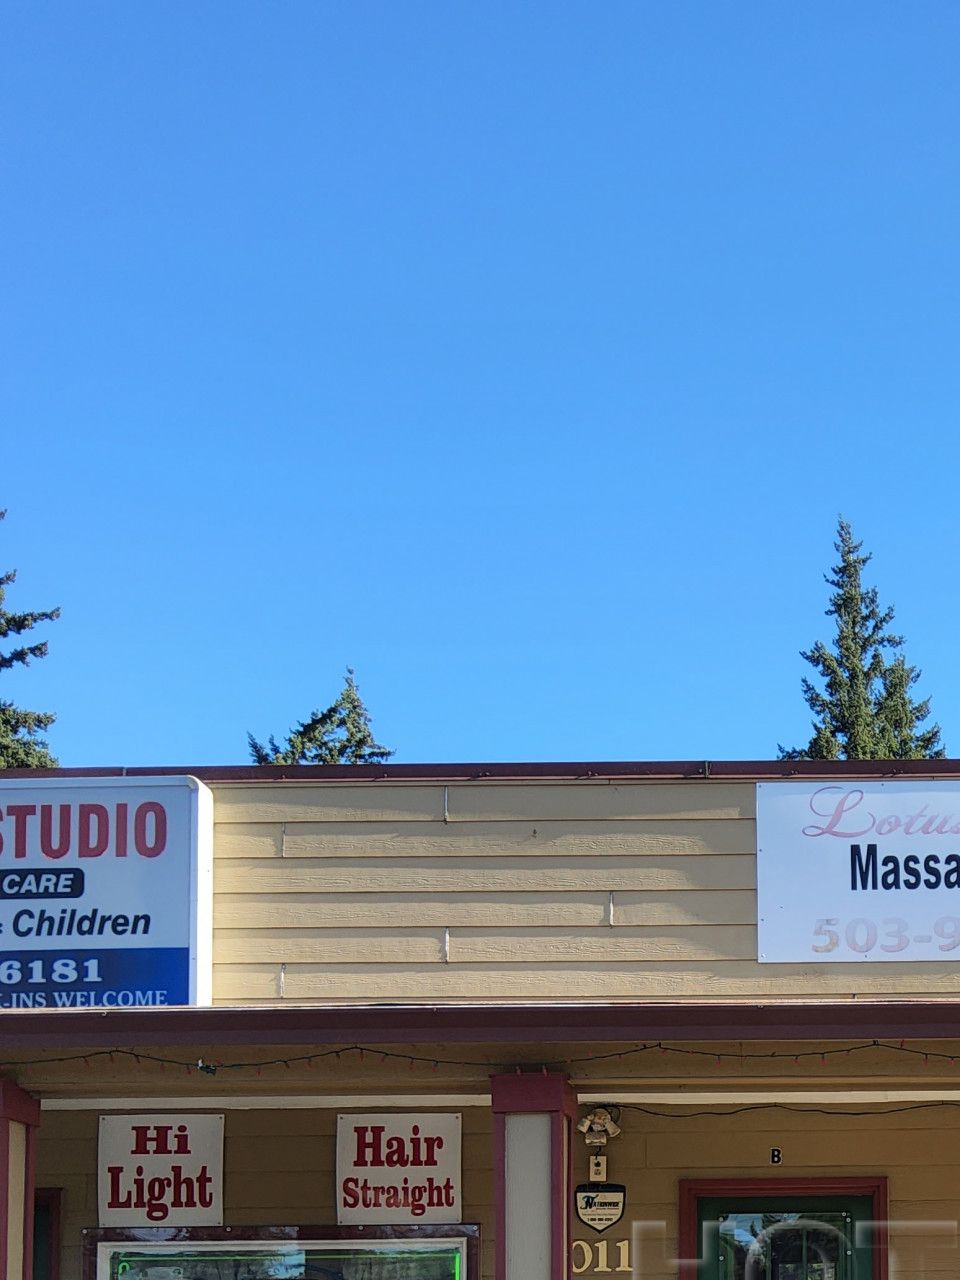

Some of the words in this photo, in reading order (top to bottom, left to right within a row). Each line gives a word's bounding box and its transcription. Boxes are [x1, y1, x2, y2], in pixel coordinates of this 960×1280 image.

[0, 801, 168, 859] TUDIO
[2, 874, 74, 894] CARE
[12, 909, 151, 938] Children
[0, 959, 103, 985] 6181
[53, 990, 168, 1009] WELCOME
[131, 1124, 192, 1155] Hi
[353, 1124, 444, 1167] Hair
[770, 1147, 782, 1165] B
[107, 1165, 214, 1222] Light
[342, 1177, 455, 1216] Straight
